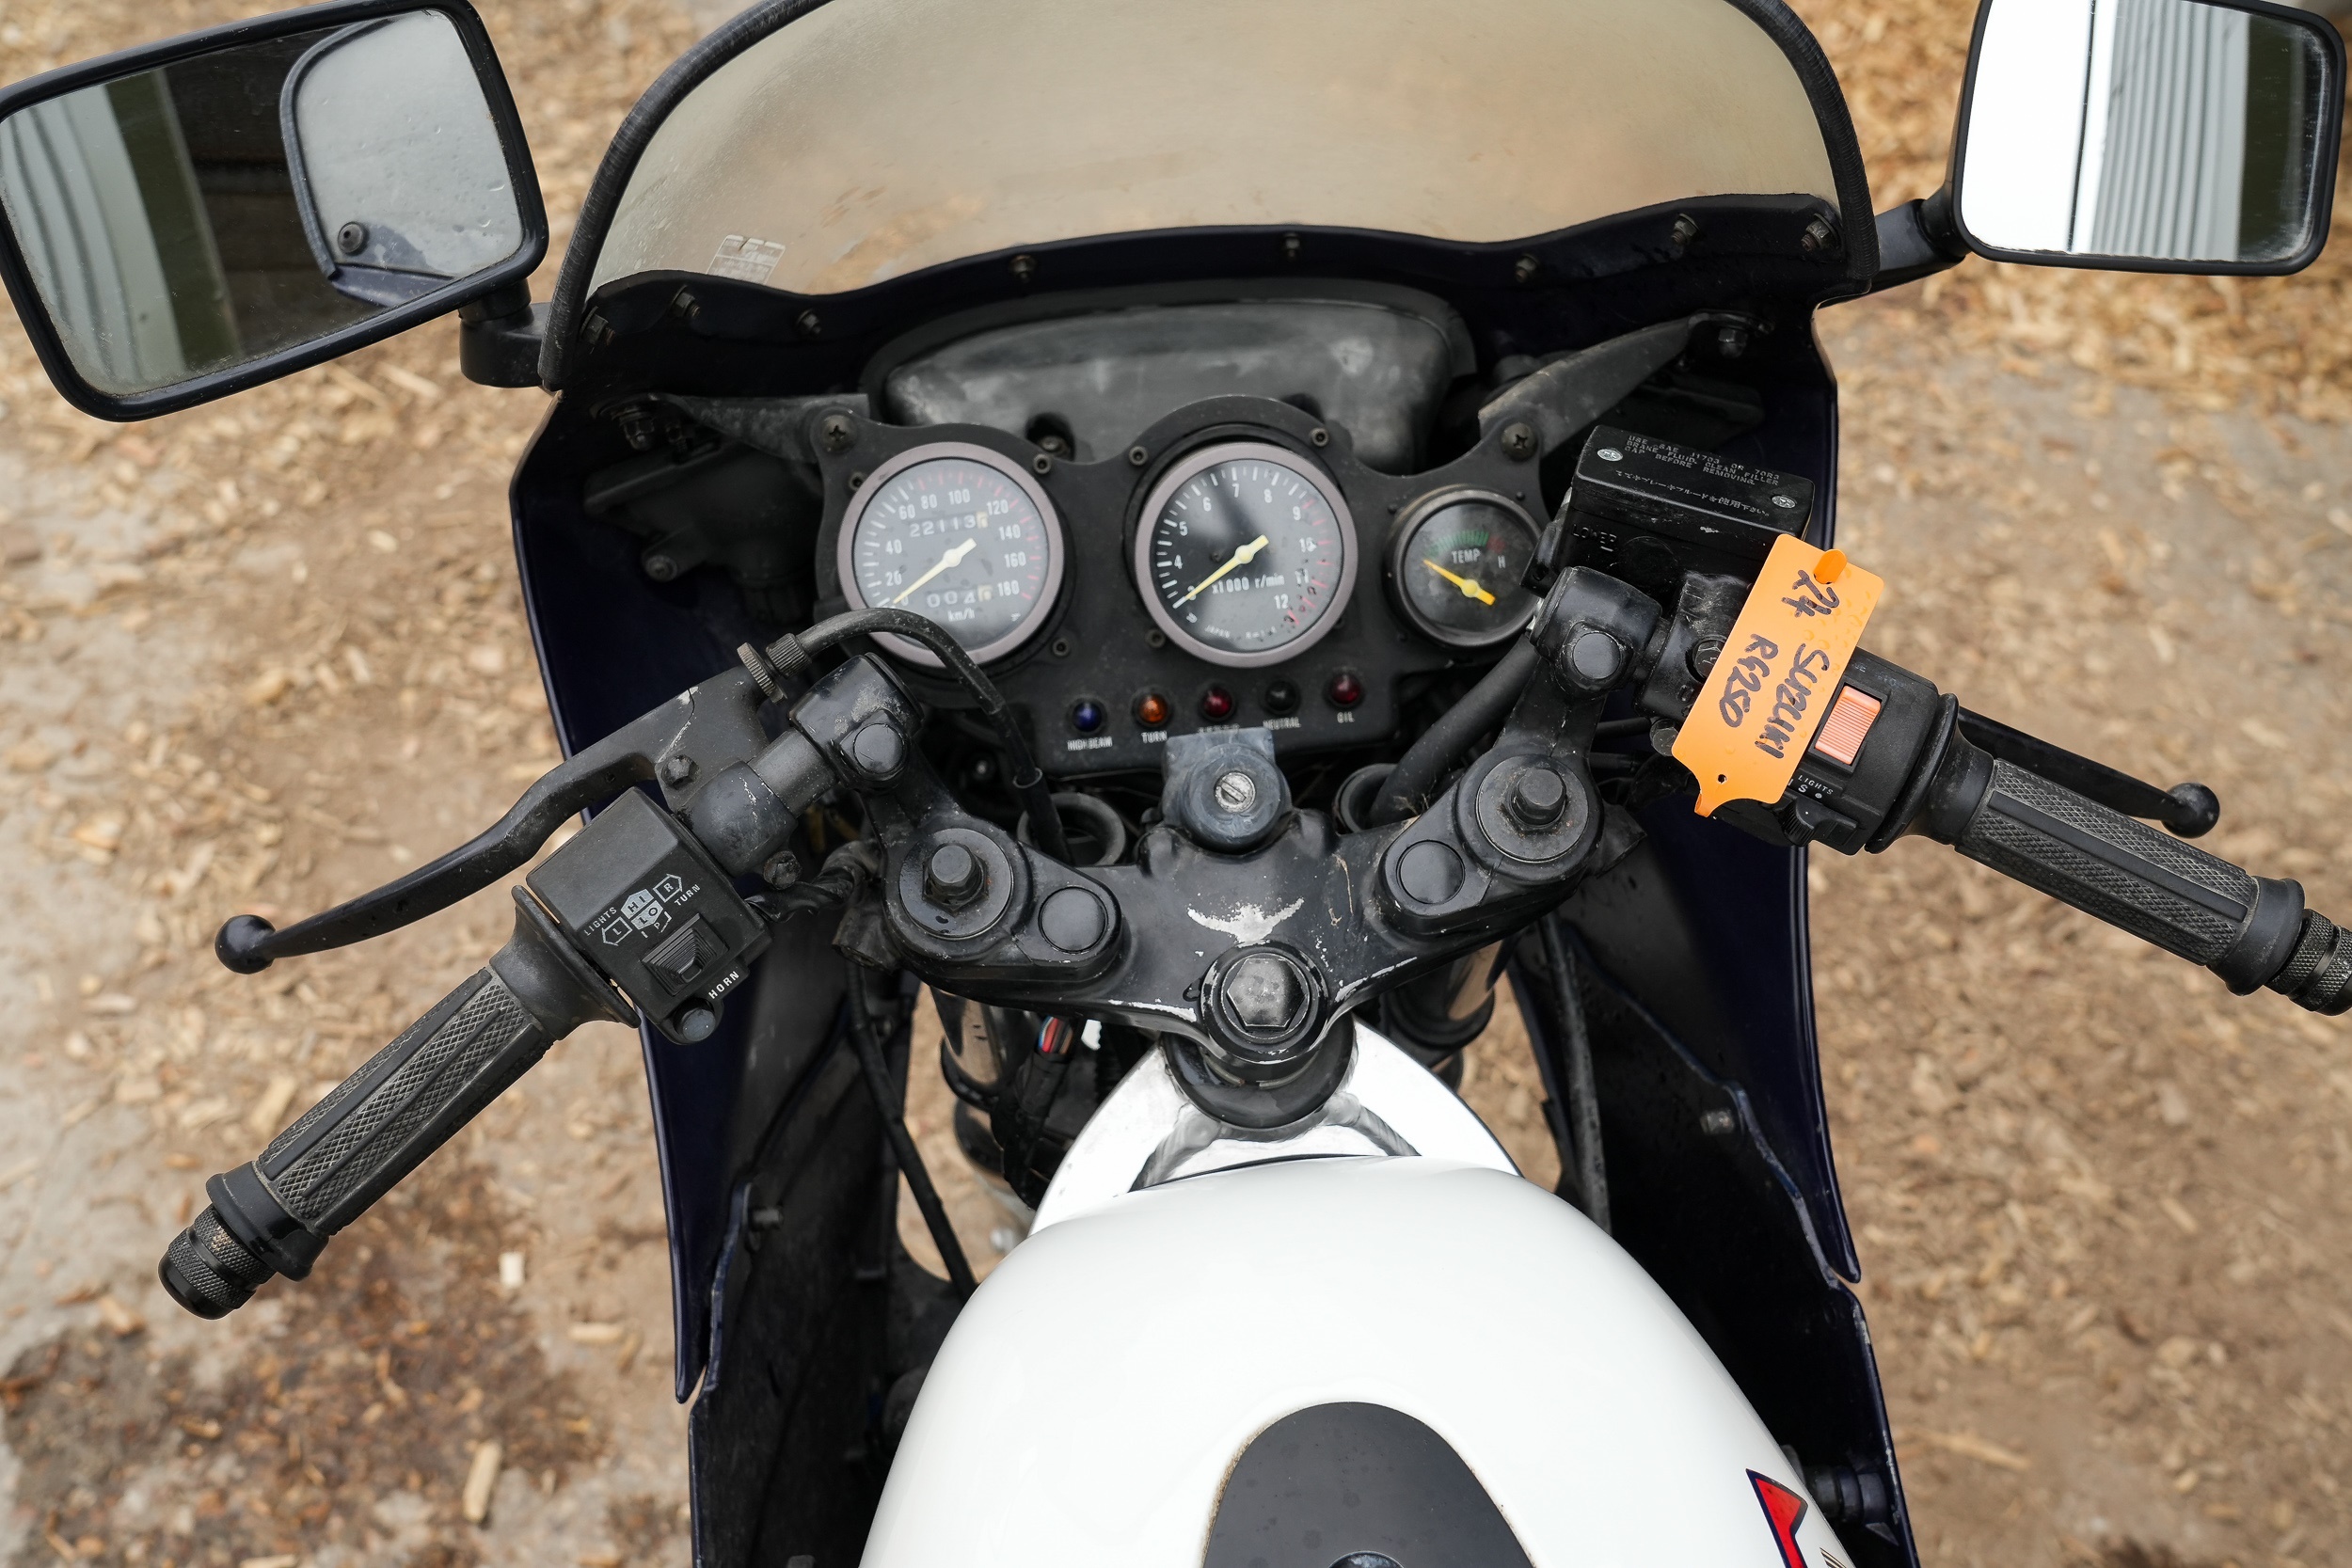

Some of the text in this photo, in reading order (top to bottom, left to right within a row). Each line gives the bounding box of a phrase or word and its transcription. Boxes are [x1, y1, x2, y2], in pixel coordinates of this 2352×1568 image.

[1624, 445, 1645, 454] CAP
[1655, 453, 1693, 468] BEFORE
[1626, 439, 1779, 486] BRAKE FLUID. CLEAN FILLER
[1628, 435, 1648, 445] USE
[1659, 443, 1679, 453] SAE
[1731, 463, 1745, 471] OR
[1755, 468, 1780, 481] 70R3
[948, 488, 971, 505] 100
[1232, 483, 1241, 499] 7
[1263, 488, 1273, 503] 8
[920, 493, 938, 510] 80
[986, 499, 1009, 515] 120
[1201, 497, 1212, 512] 6
[898, 503, 916, 520] 60
[1292, 505, 1301, 521] 9
[998, 523, 1022, 541] 140
[1179, 521, 1188, 536] 5
[885, 538, 902, 555] 40
[1004, 550, 1027, 568] 160
[1174, 554, 1184, 570] 4
[1451, 547, 1481, 564] TEMP
[1497, 555, 1506, 569] H
[884, 569, 902, 587] 20
[1295, 568, 1310, 584] 11
[997, 579, 1020, 597] 180
[1781, 569, 1840, 619] 24
[1273, 593, 1289, 610] 12
[947, 607, 976, 622] km/h
[1719, 633, 1779, 728] RG250
[1755, 642, 1831, 759] SUZUKI
[1263, 716, 1302, 731] NEUTRAL
[1336, 711, 1355, 724] OIL
[1140, 730, 1168, 744] TURN
[1798, 774, 1834, 795] LIGHTS
[1798, 784, 1808, 793] S
[663, 882, 674, 893] R
[674, 883, 701, 907] TURN
[627, 895, 646, 912] HI
[583, 906, 617, 936] LIGHTS
[639, 907, 659, 925] LO
[612, 927, 622, 936] L
[707, 971, 739, 1000] HORN
